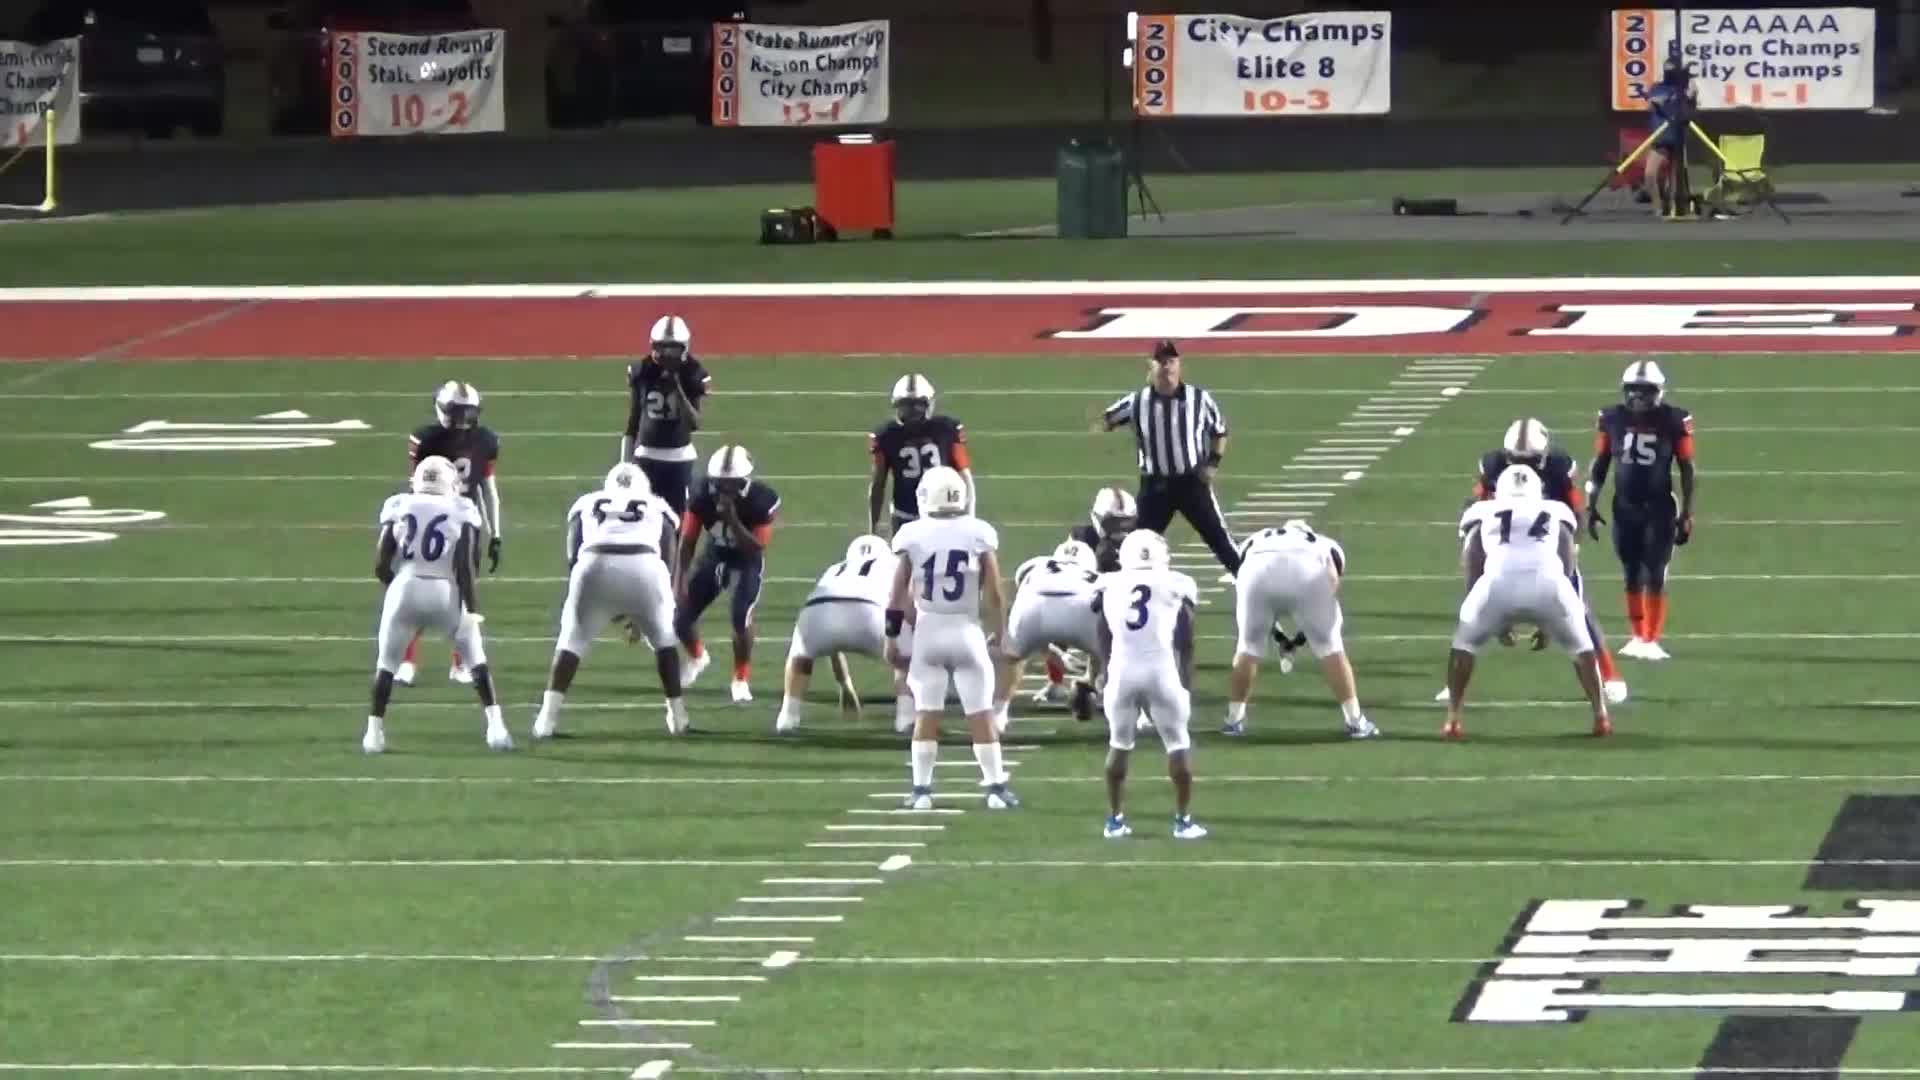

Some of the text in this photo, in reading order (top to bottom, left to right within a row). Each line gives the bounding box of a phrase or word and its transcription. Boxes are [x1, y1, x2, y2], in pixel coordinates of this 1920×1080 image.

[367, 36, 431, 57] Second
[1187, 18, 1385, 46] City Champs
[816, 53, 880, 76] Champs
[1145, 24, 1165, 106] 2002
[1625, 15, 1648, 100] 2003
[1670, 39, 1860, 60] egion Champs
[337, 37, 352, 129] 2000
[420, 58, 491, 86] ayoffs
[719, 29, 734, 121] 2001
[1237, 57, 1335, 79] Elite 8
[1687, 61, 1843, 82] City Champs
[760, 78, 868, 99] City Champs
[1243, 89, 1331, 111] 10-3
[1725, 83, 1809, 105] 11-1
[391, 91, 468, 128] 10-2
[899, 443, 941, 479] 33
[1620, 432, 1657, 467] 15
[400, 513, 448, 562] 26
[920, 549, 970, 602] 15
[1126, 584, 1153, 631] 3
